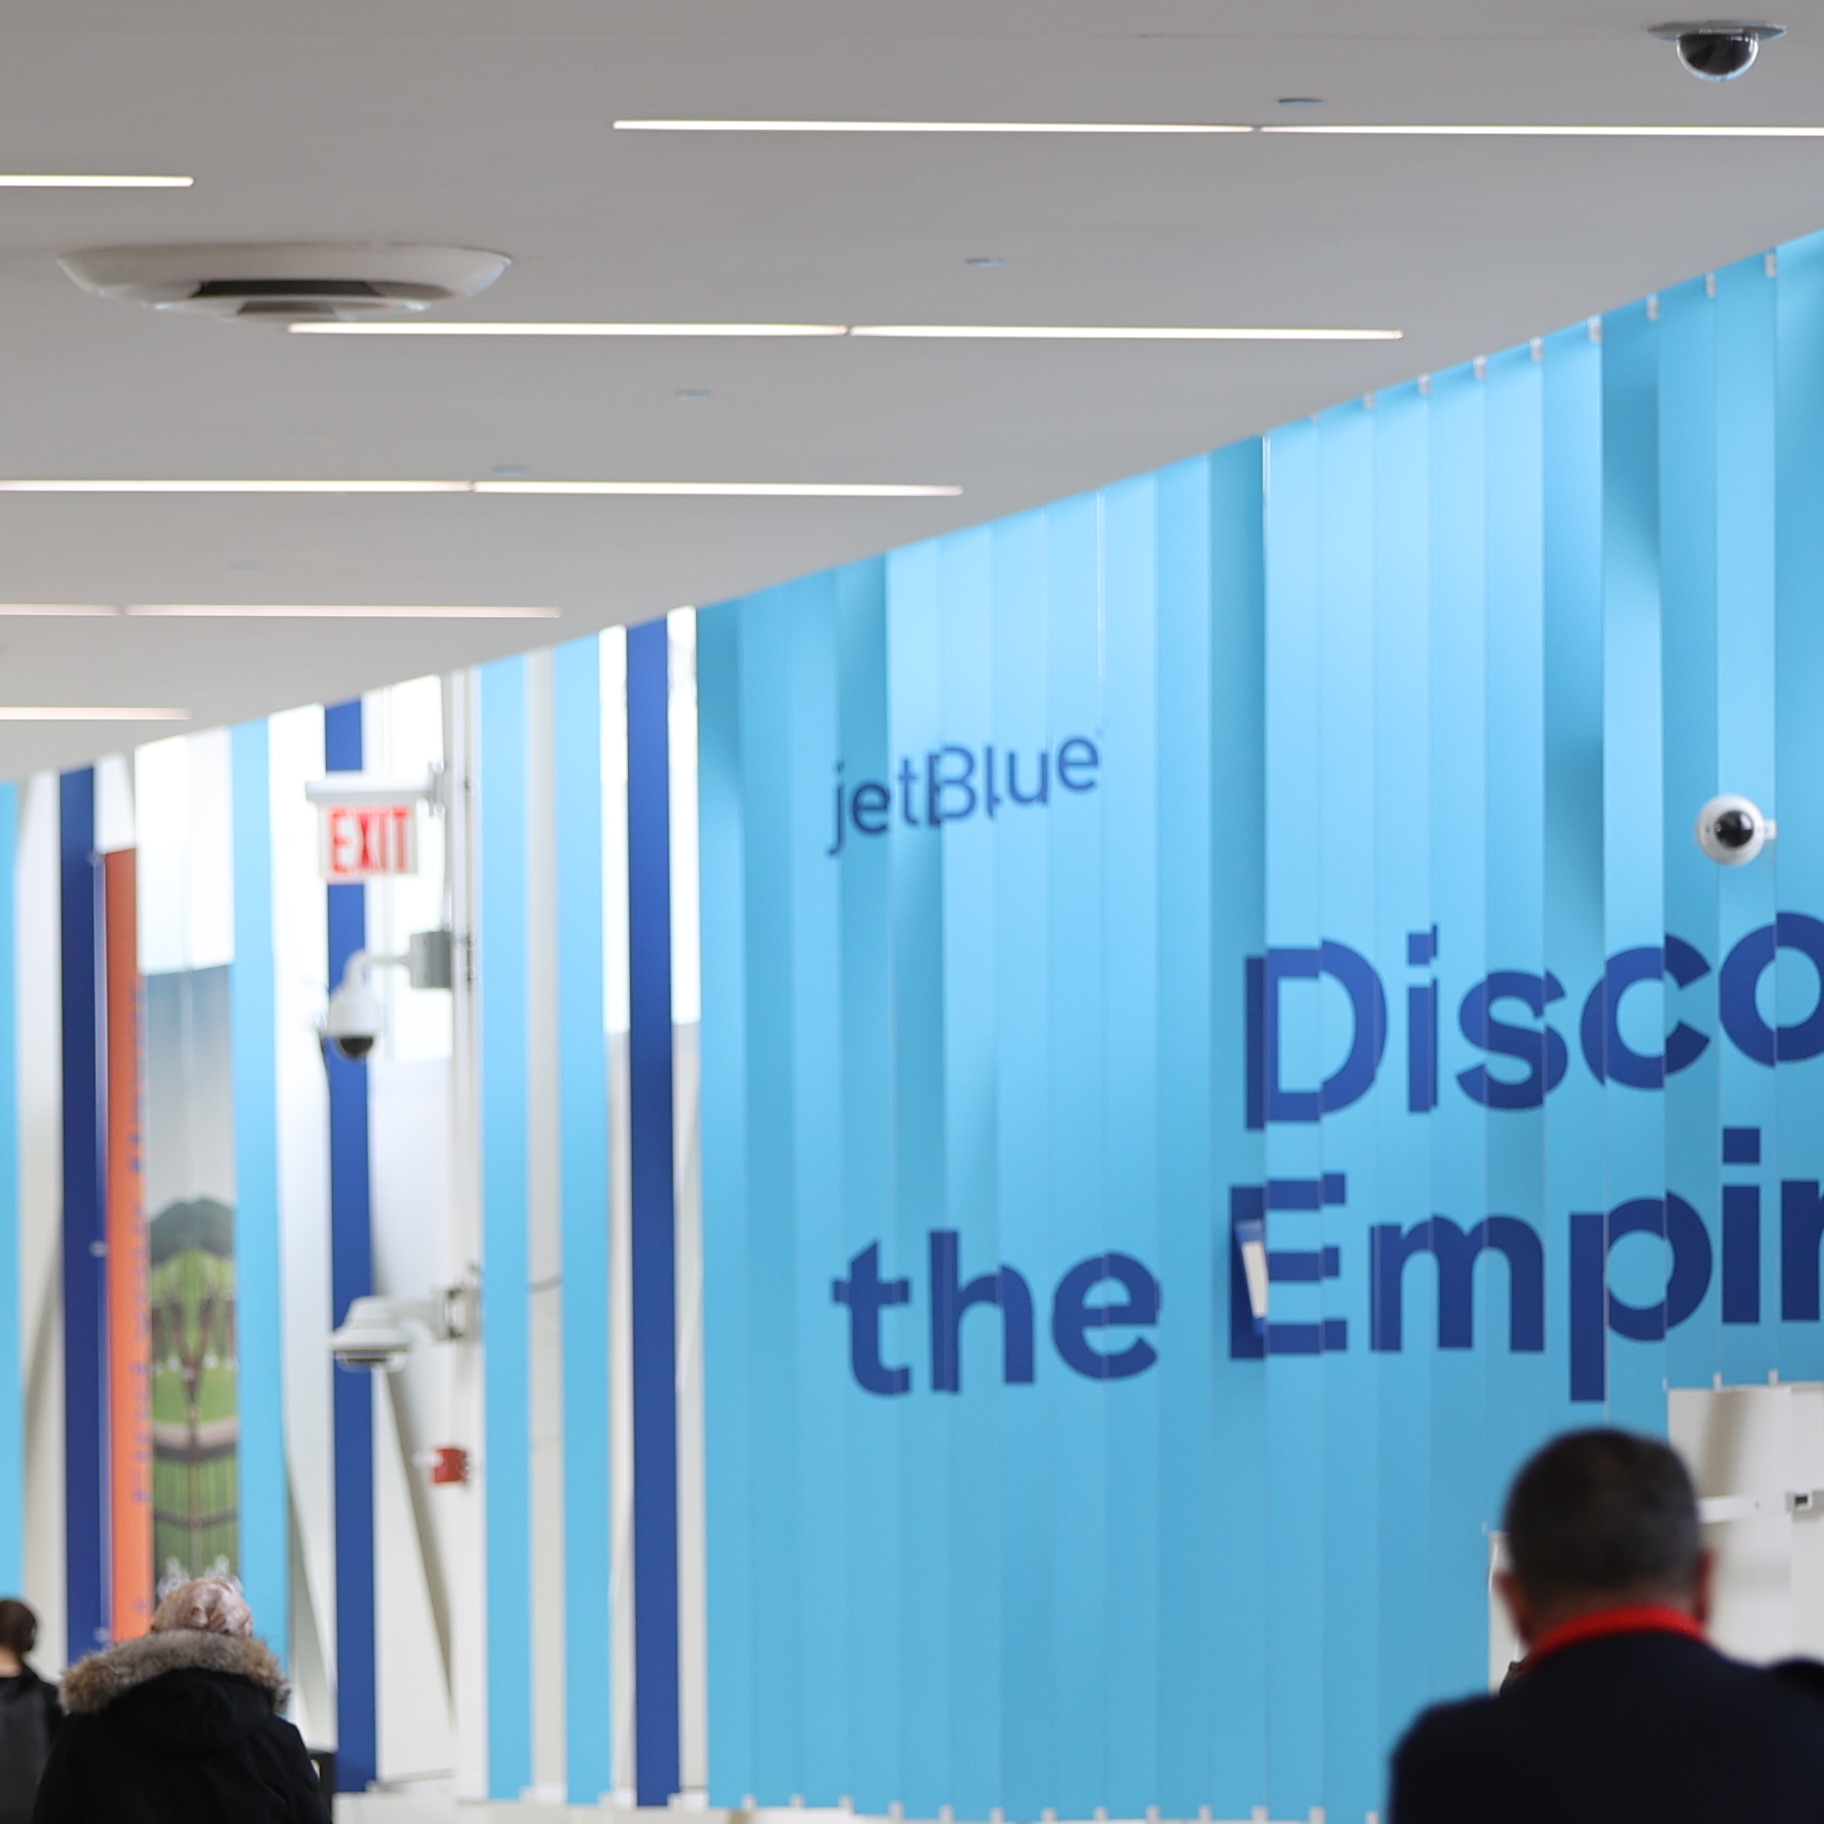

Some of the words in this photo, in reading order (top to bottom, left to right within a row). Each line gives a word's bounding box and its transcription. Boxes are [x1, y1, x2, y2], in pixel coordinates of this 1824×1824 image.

[330, 807, 410, 875] EXIT
[826, 737, 1099, 858] jetBlue
[832, 1231, 1160, 1398] the
